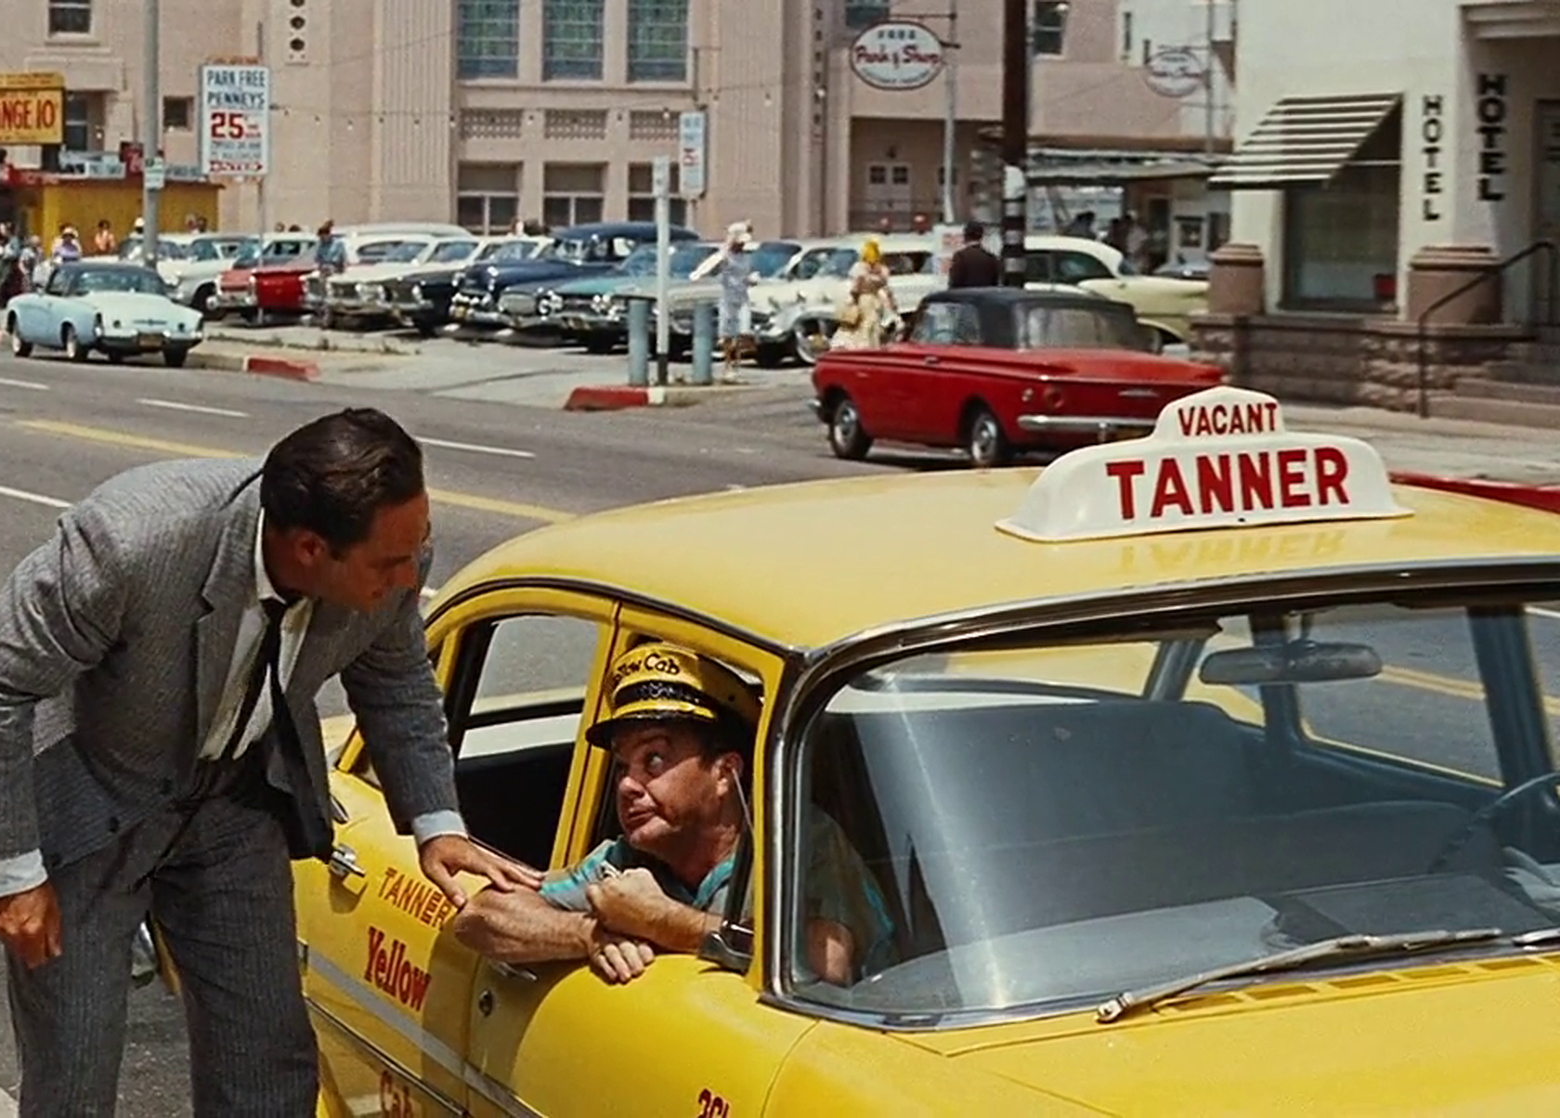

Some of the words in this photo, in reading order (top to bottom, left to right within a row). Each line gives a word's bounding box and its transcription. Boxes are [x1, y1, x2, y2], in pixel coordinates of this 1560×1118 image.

[207, 70, 236, 86] PARK
[240, 70, 265, 88] FREE
[855, 44, 889, 63] Park
[902, 44, 940, 66] Shop
[1423, 95, 1443, 221] HOTEL
[1479, 74, 1506, 201] HOTEL
[1178, 403, 1278, 436] VACANT
[1105, 447, 1350, 520] TANNER
[644, 653, 680, 675] Cab
[378, 867, 453, 931] TANNER
[364, 925, 433, 1011] Yellow
